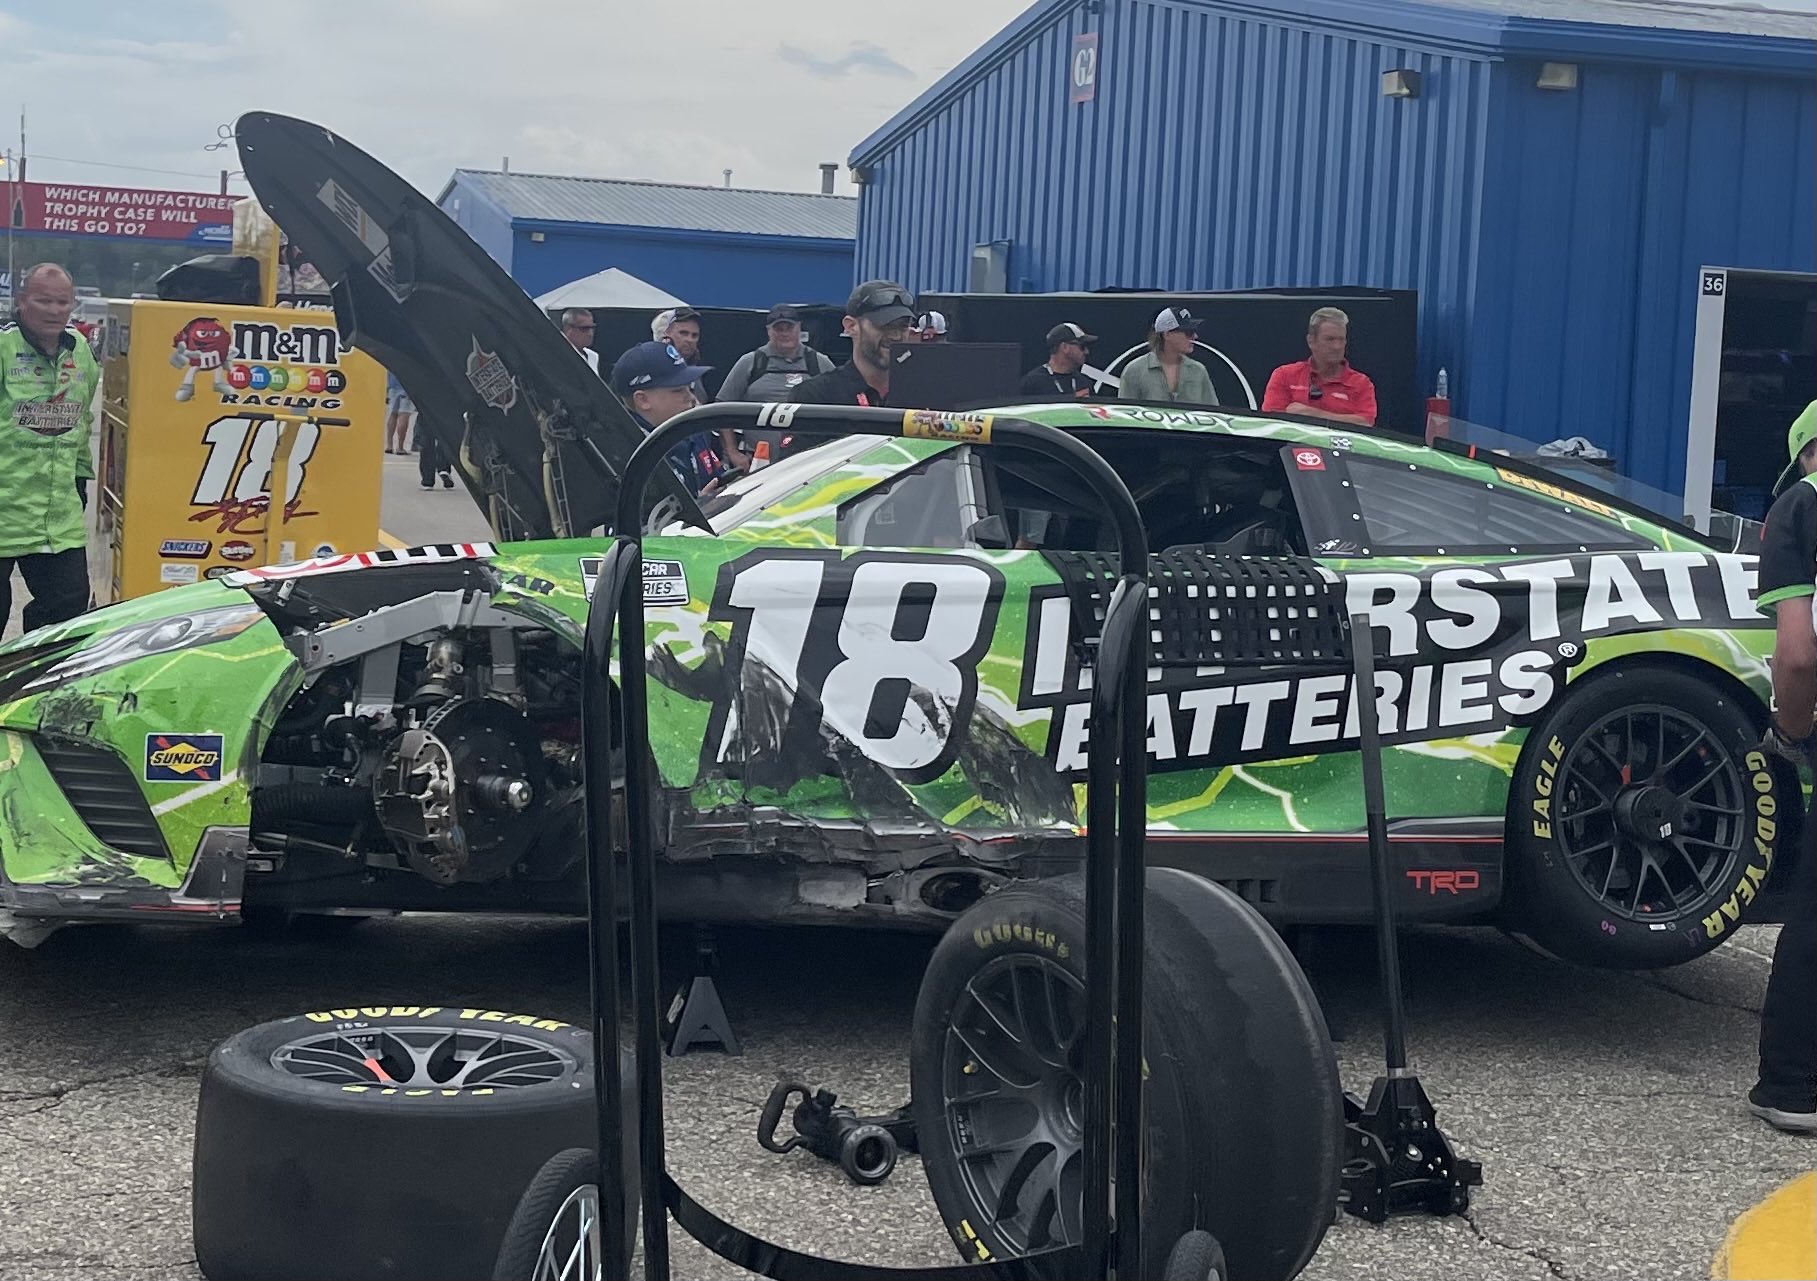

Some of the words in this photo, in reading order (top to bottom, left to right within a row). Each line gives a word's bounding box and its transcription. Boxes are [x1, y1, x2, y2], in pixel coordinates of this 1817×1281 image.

[1074, 47, 1095, 87] G2
[44, 187, 100, 203] WHICH
[44, 202, 110, 218] TROPHY
[113, 207, 155, 221] CASE
[161, 210, 198, 223] WILL
[43, 217, 79, 231] THIS
[84, 221, 110, 233] GO
[115, 222, 147, 235] TO?
[1703, 277, 1723, 292] 36
[221, 394, 341, 409] RACING
[756, 402, 801, 428] 18
[190, 415, 321, 506] 18
[714, 556, 996, 773] 18
[153, 752, 216, 765] SUNOCO
[1533, 735, 1566, 839] EAGLE
[1406, 871, 1479, 894] TRD
